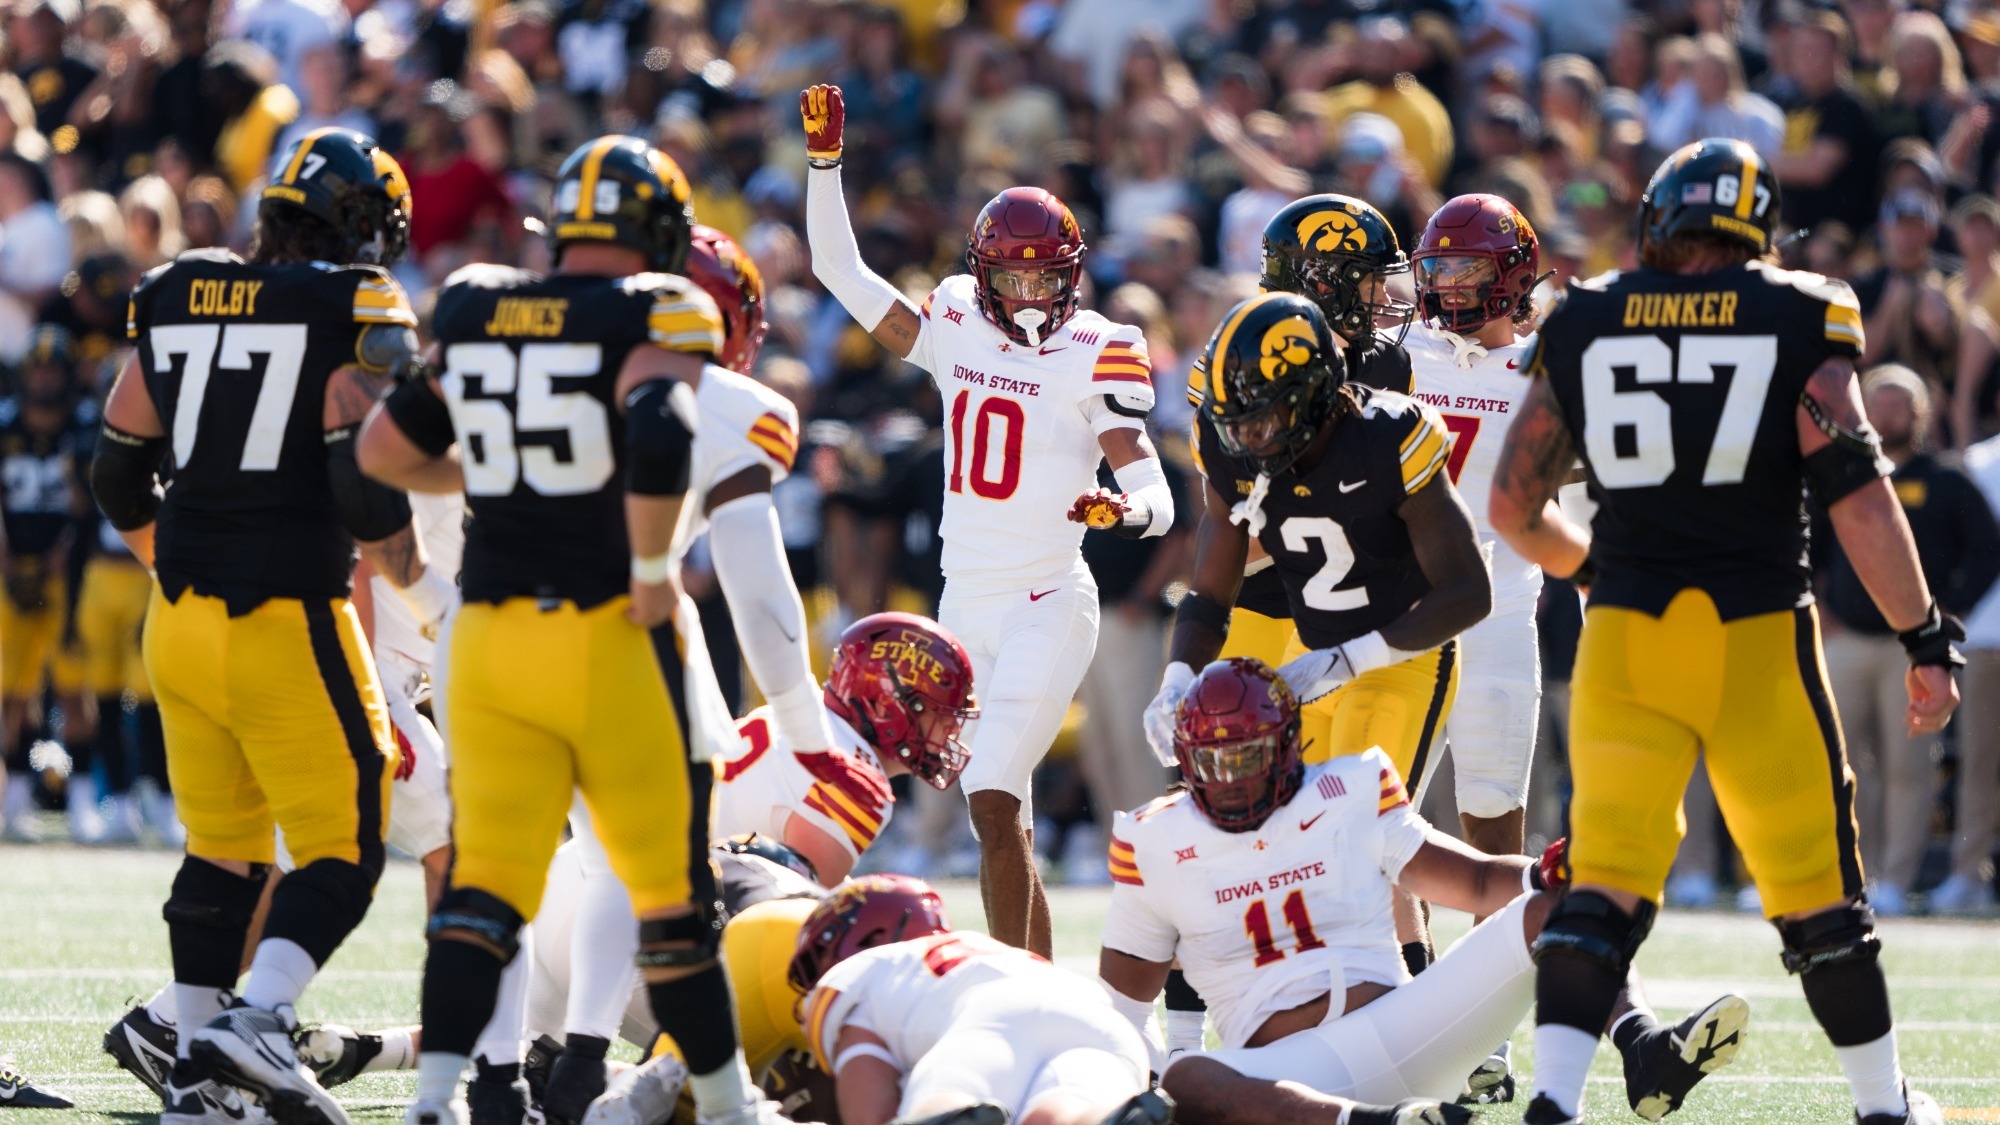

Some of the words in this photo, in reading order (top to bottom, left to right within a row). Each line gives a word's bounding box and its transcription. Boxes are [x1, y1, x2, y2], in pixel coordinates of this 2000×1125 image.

[1715, 174, 1771, 217] 67
[189, 279, 263, 316] COLBY
[485, 298, 568, 337] JONES
[942, 305, 965, 326] XII
[1623, 292, 1738, 327] DUNKER
[150, 324, 308, 470] 77
[953, 364, 985, 386] IOWA
[988, 375, 1040, 397] STATE
[441, 342, 616, 496] 65
[1454, 396, 1510, 413] STATE
[1581, 334, 1778, 490] 67
[949, 386, 1026, 502] 10
[1280, 517, 1370, 611] 2
[870, 640, 945, 684] STATE
[1174, 845, 1199, 864] XII
[1215, 882, 1264, 905] IOWA
[1269, 861, 1326, 890] STATE
[1244, 888, 1328, 968] 11
